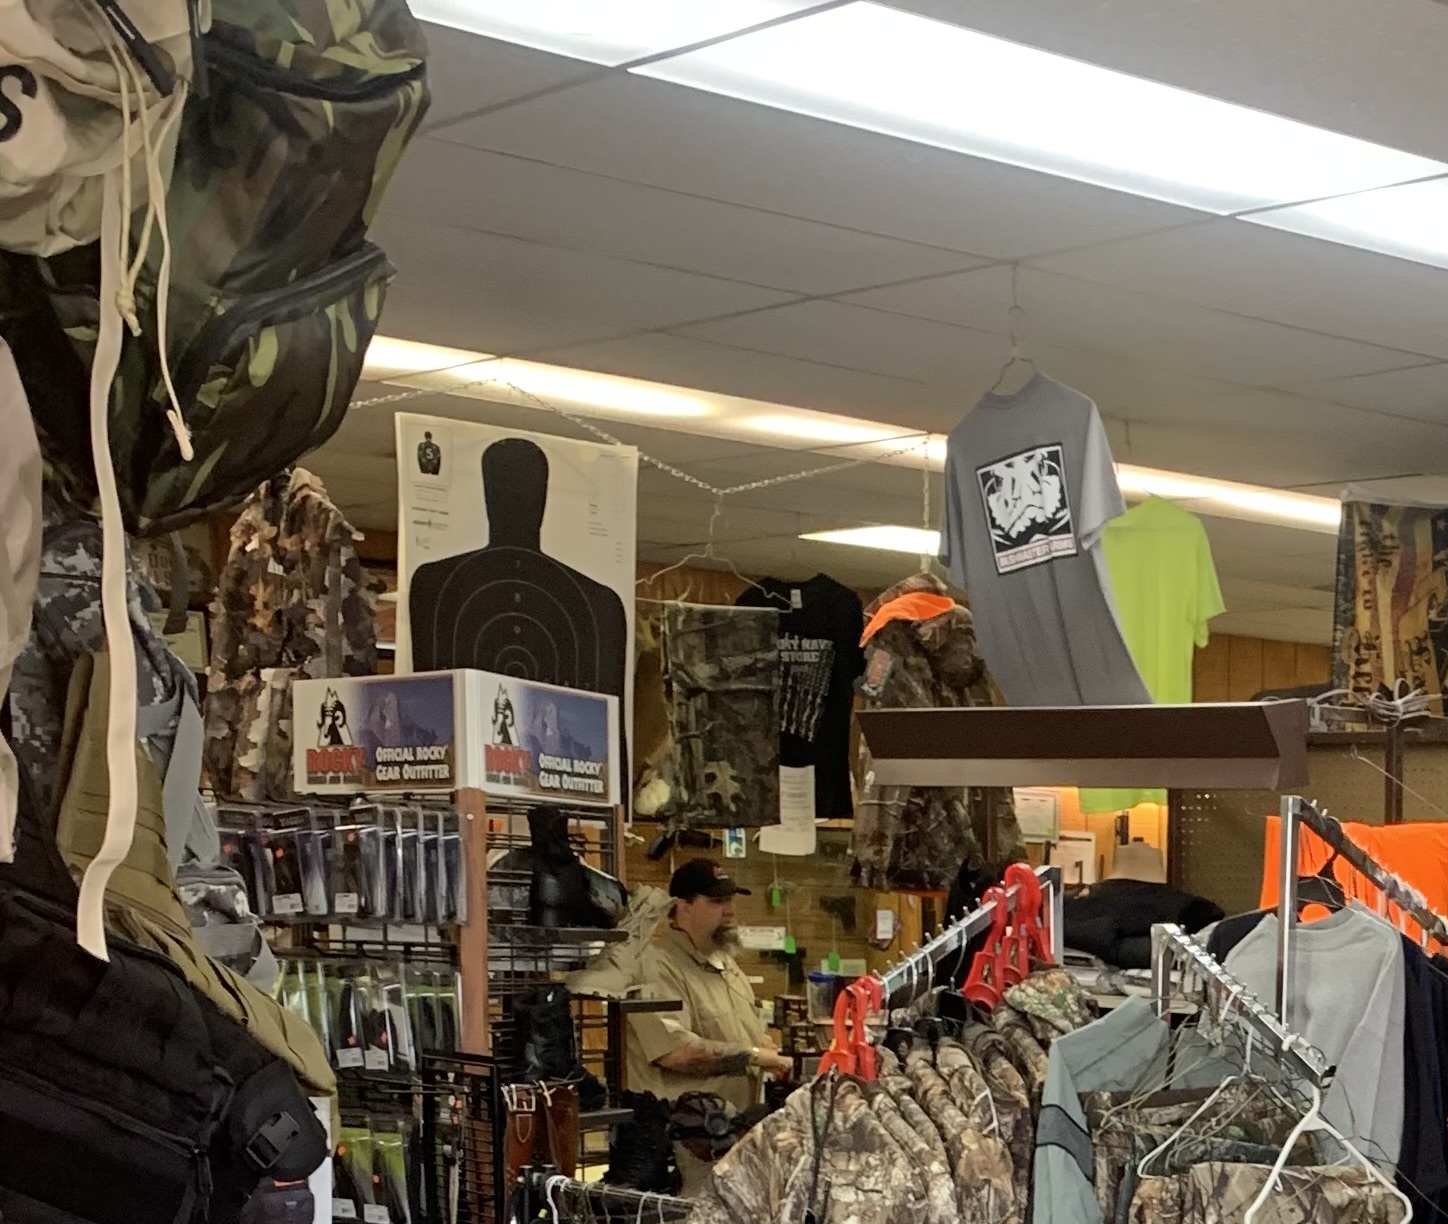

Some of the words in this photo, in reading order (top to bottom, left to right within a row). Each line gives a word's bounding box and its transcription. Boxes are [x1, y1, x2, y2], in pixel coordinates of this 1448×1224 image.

[375, 746, 414, 763] OFFICIAL
[416, 745, 448, 761] ROCKY
[539, 752, 572, 773] OFFICIAL
[573, 759, 601, 776] ROCKY
[375, 764, 401, 781] GEAR
[402, 763, 450, 780] OUTFITTER
[539, 770, 561, 788] GEAR
[562, 774, 604, 793] OUTFITTER
